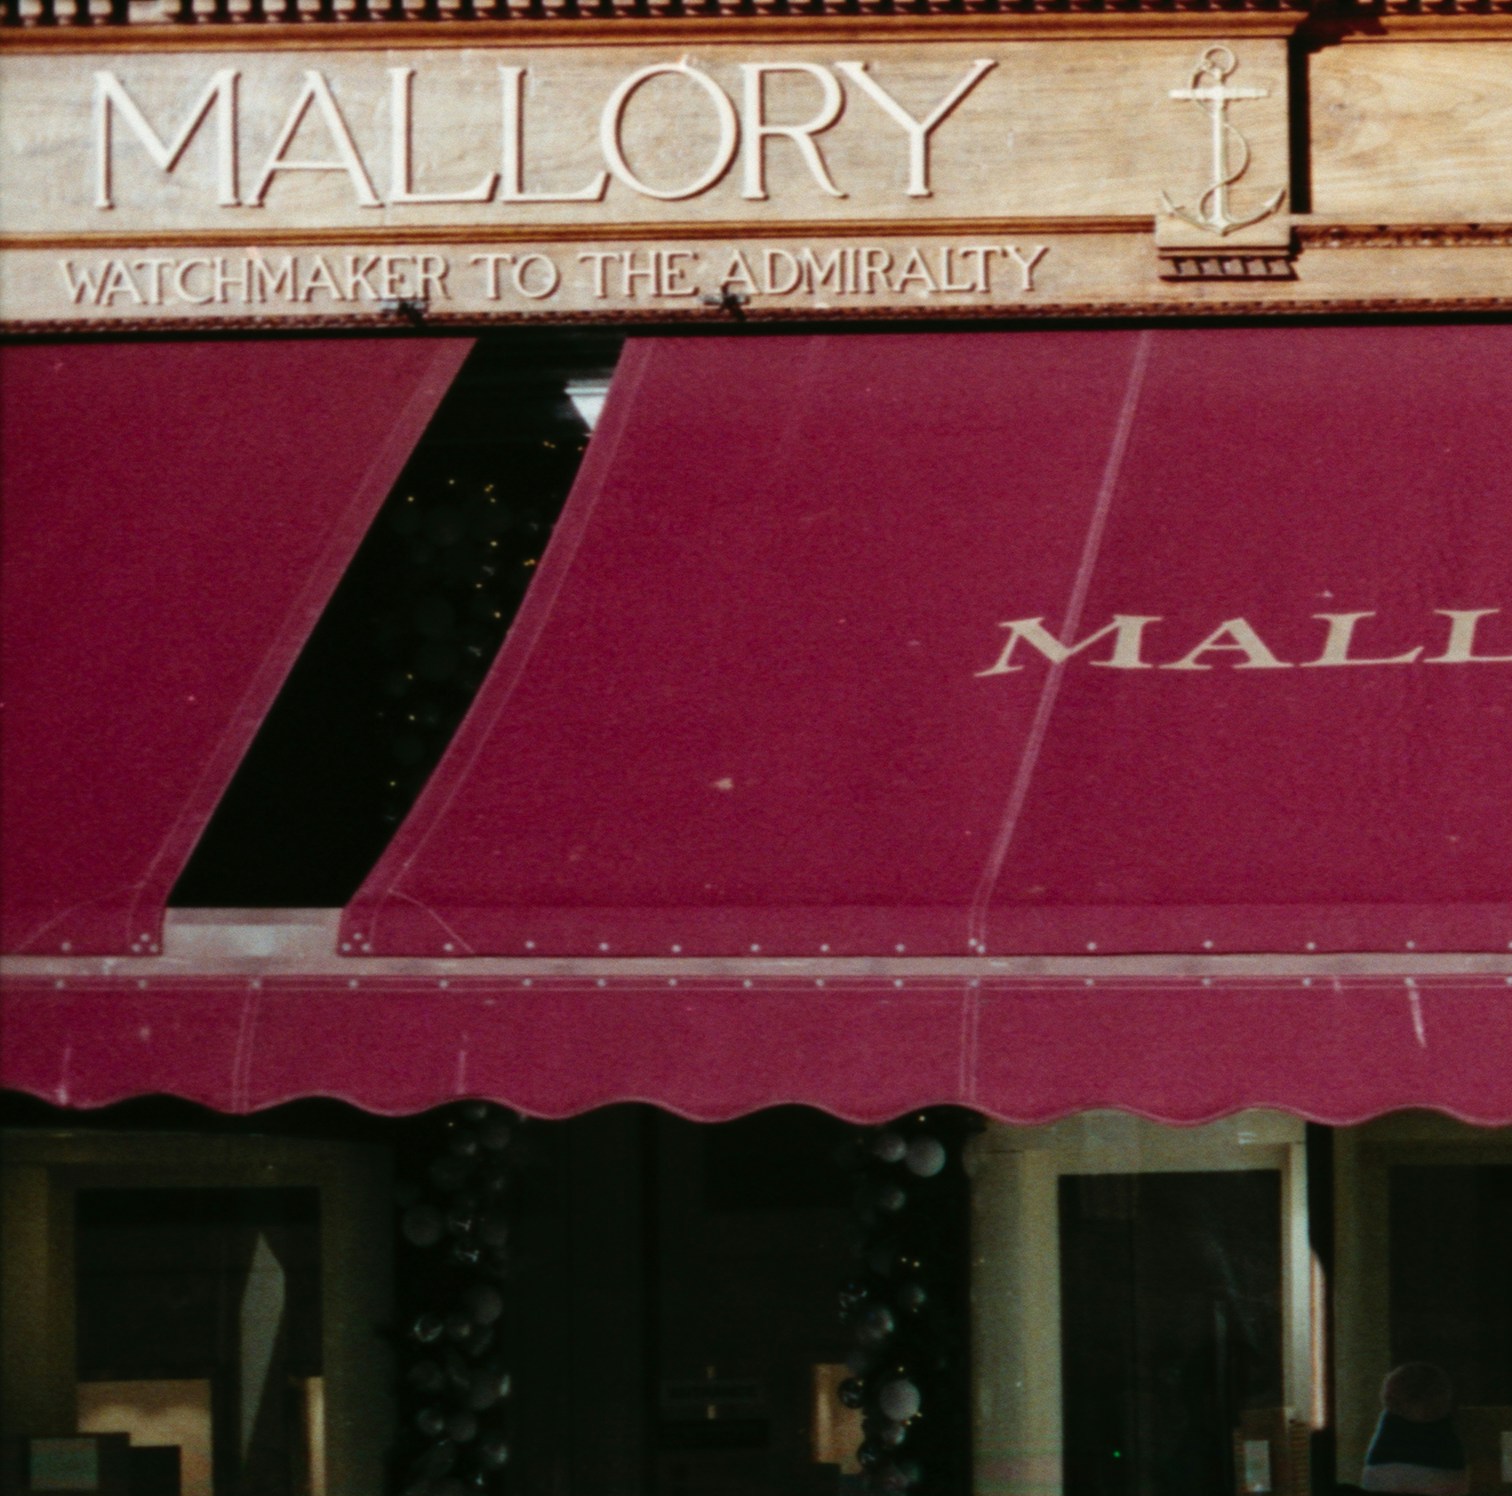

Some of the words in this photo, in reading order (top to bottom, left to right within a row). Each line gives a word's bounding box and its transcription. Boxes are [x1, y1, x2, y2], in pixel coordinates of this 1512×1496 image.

[93, 55, 998, 208] MALLORY
[58, 253, 451, 306] WATCHMAKER
[471, 252, 562, 301] TO
[578, 249, 700, 299] THE
[720, 244, 1051, 297] ADMIRALTY
